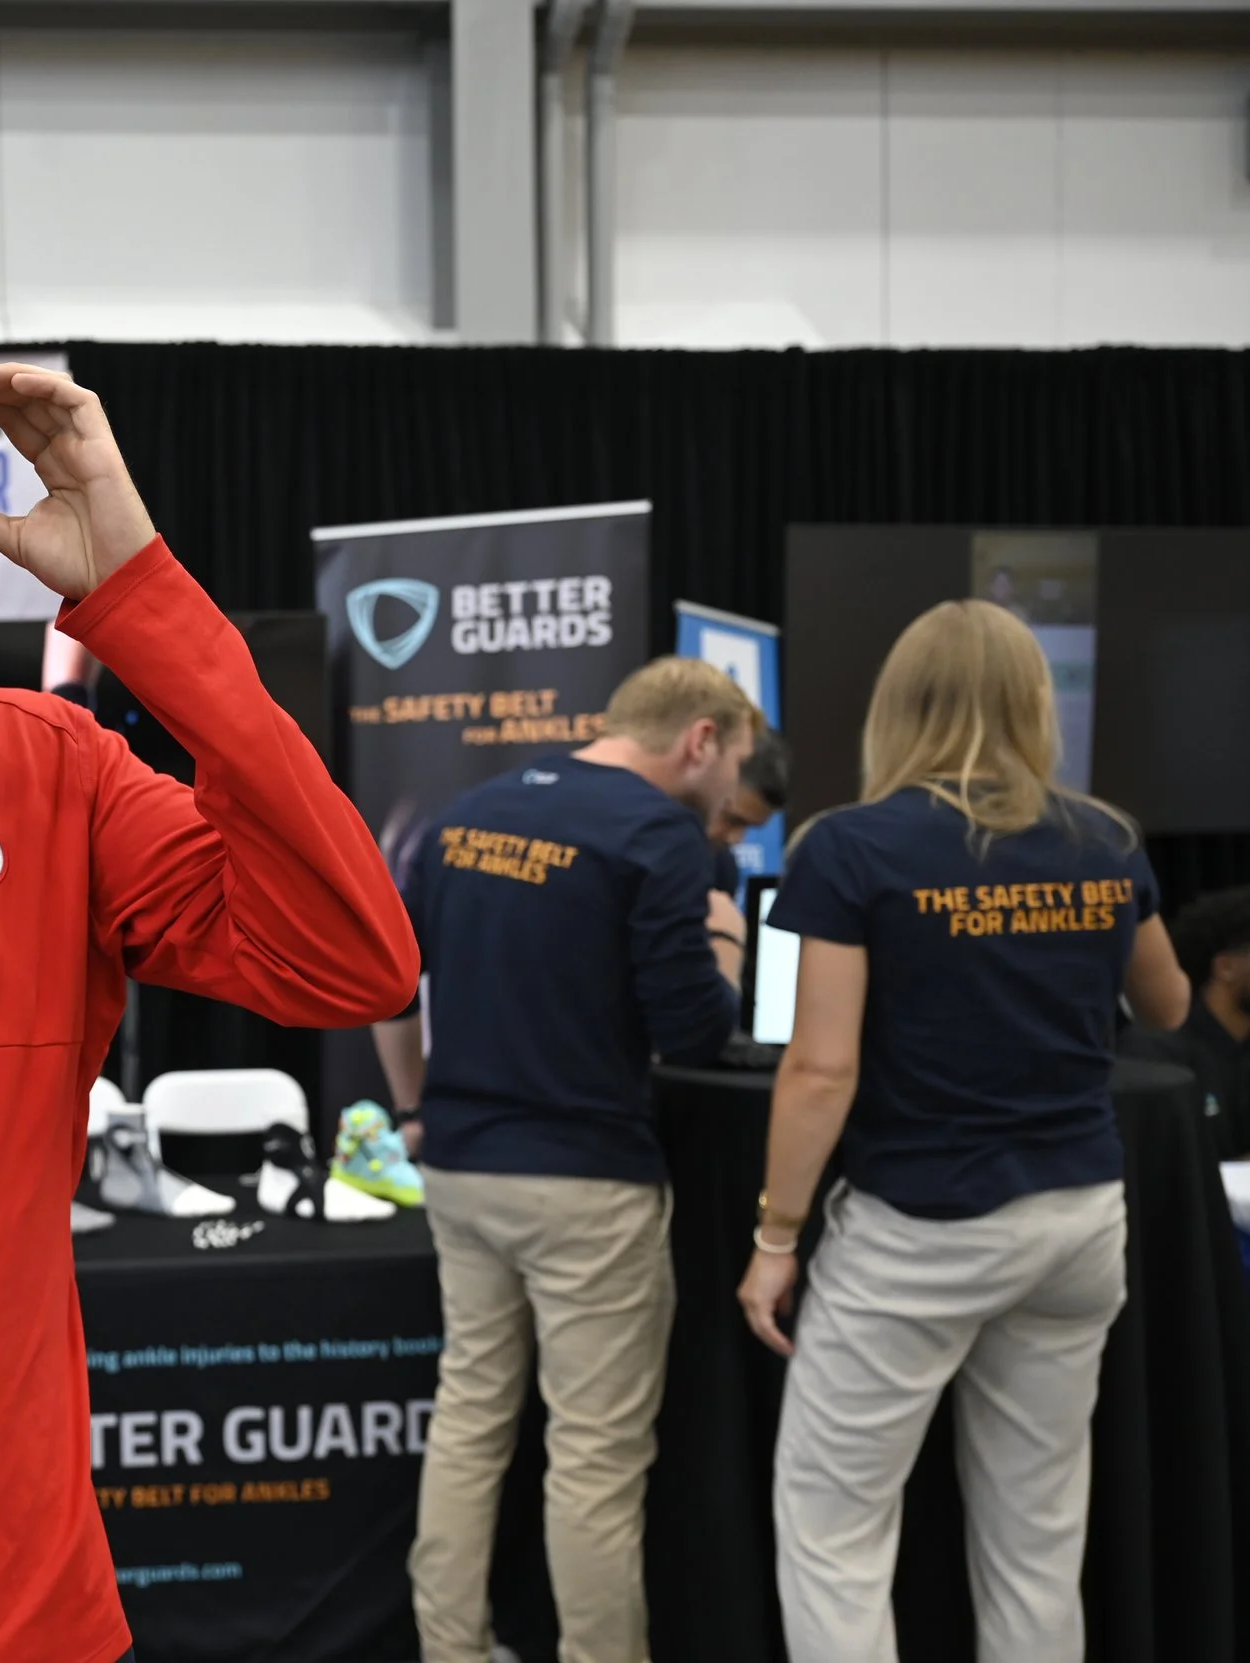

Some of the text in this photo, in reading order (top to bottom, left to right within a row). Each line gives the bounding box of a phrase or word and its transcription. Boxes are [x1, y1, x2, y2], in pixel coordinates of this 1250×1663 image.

[452, 575, 612, 619] BETTER
[452, 611, 613, 655] GUARDS
[383, 691, 485, 724] SAFETY
[489, 688, 557, 719] BELT
[526, 839, 578, 869] BELT
[913, 878, 1133, 913] THE SAFETY BELT
[950, 906, 1116, 937] FOR ANKLES
[121, 1344, 179, 1369] ankle
[180, 1342, 257, 1370] injuries
[258, 1341, 281, 1363] to
[282, 1339, 318, 1363] the
[319, 1336, 390, 1362] history
[392, 1333, 442, 1357] book
[90, 1399, 437, 1470] TER GUARD
[130, 1483, 185, 1509] BELT
[189, 1481, 238, 1506] FOR
[240, 1476, 331, 1504] ANKLES
